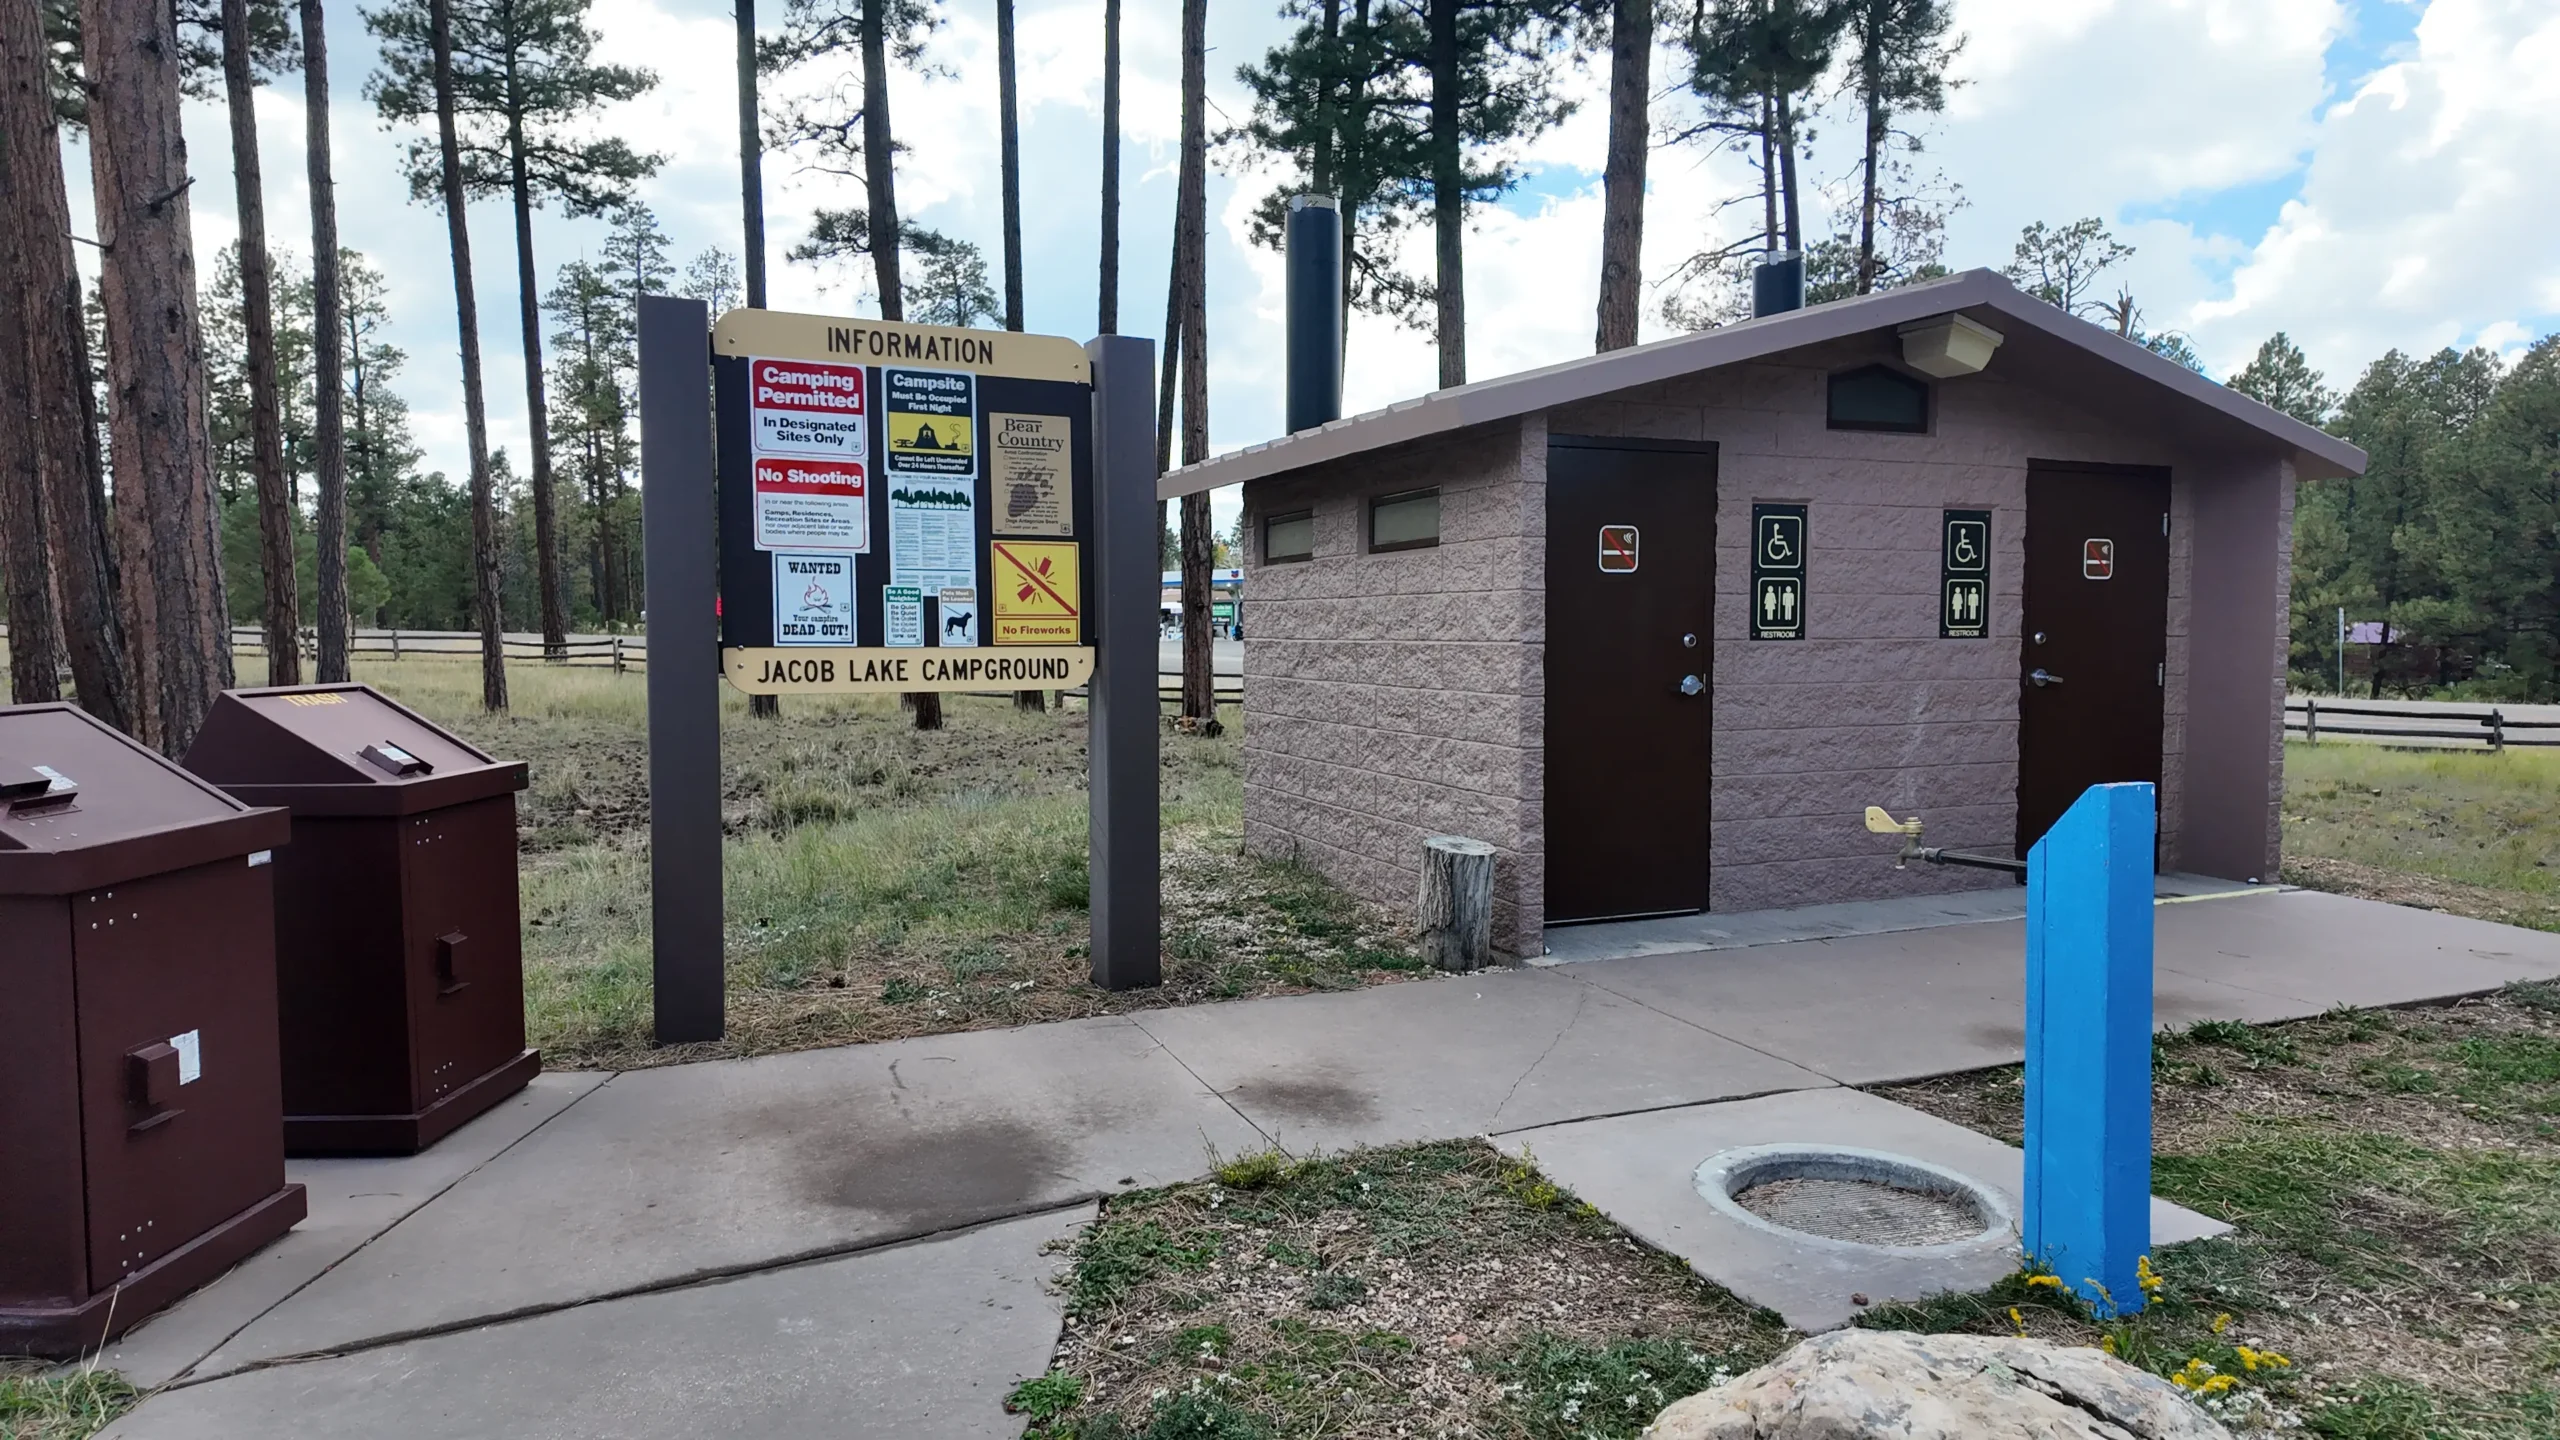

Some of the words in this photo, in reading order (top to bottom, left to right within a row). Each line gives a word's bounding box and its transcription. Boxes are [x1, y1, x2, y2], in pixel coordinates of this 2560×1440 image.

[828, 327, 993, 365] INFORMATION
[763, 367, 855, 391] Camping
[893, 374, 965, 391] Campsite
[759, 387, 859, 409] Permitted
[892, 391, 914, 400] Must
[915, 393, 927, 401] Be
[928, 394, 967, 404] Occupied
[908, 402, 928, 411] First
[929, 404, 952, 413] Night
[764, 417, 777, 427] In
[780, 417, 856, 432] Designated
[1004, 418, 1042, 433] Bear
[777, 430, 811, 443] Sites
[814, 433, 844, 446] Only
[998, 432, 1064, 452] Country
[758, 468, 783, 482] No
[787, 469, 862, 488] Shooting
[805, 500, 832, 508] following
[791, 523, 816, 531] adjacent
[788, 562, 841, 574] WANTED
[793, 614, 809, 622] Your
[811, 615, 839, 623] campfire
[1003, 626, 1017, 635] No
[1020, 625, 1071, 635] Fireworks
[1760, 631, 1796, 639] RESTROOM
[757, 660, 835, 683] JACOB
[850, 659, 909, 682] LAKE
[922, 658, 1069, 681] CAMPGROUND
[280, 692, 348, 706] TRASH
